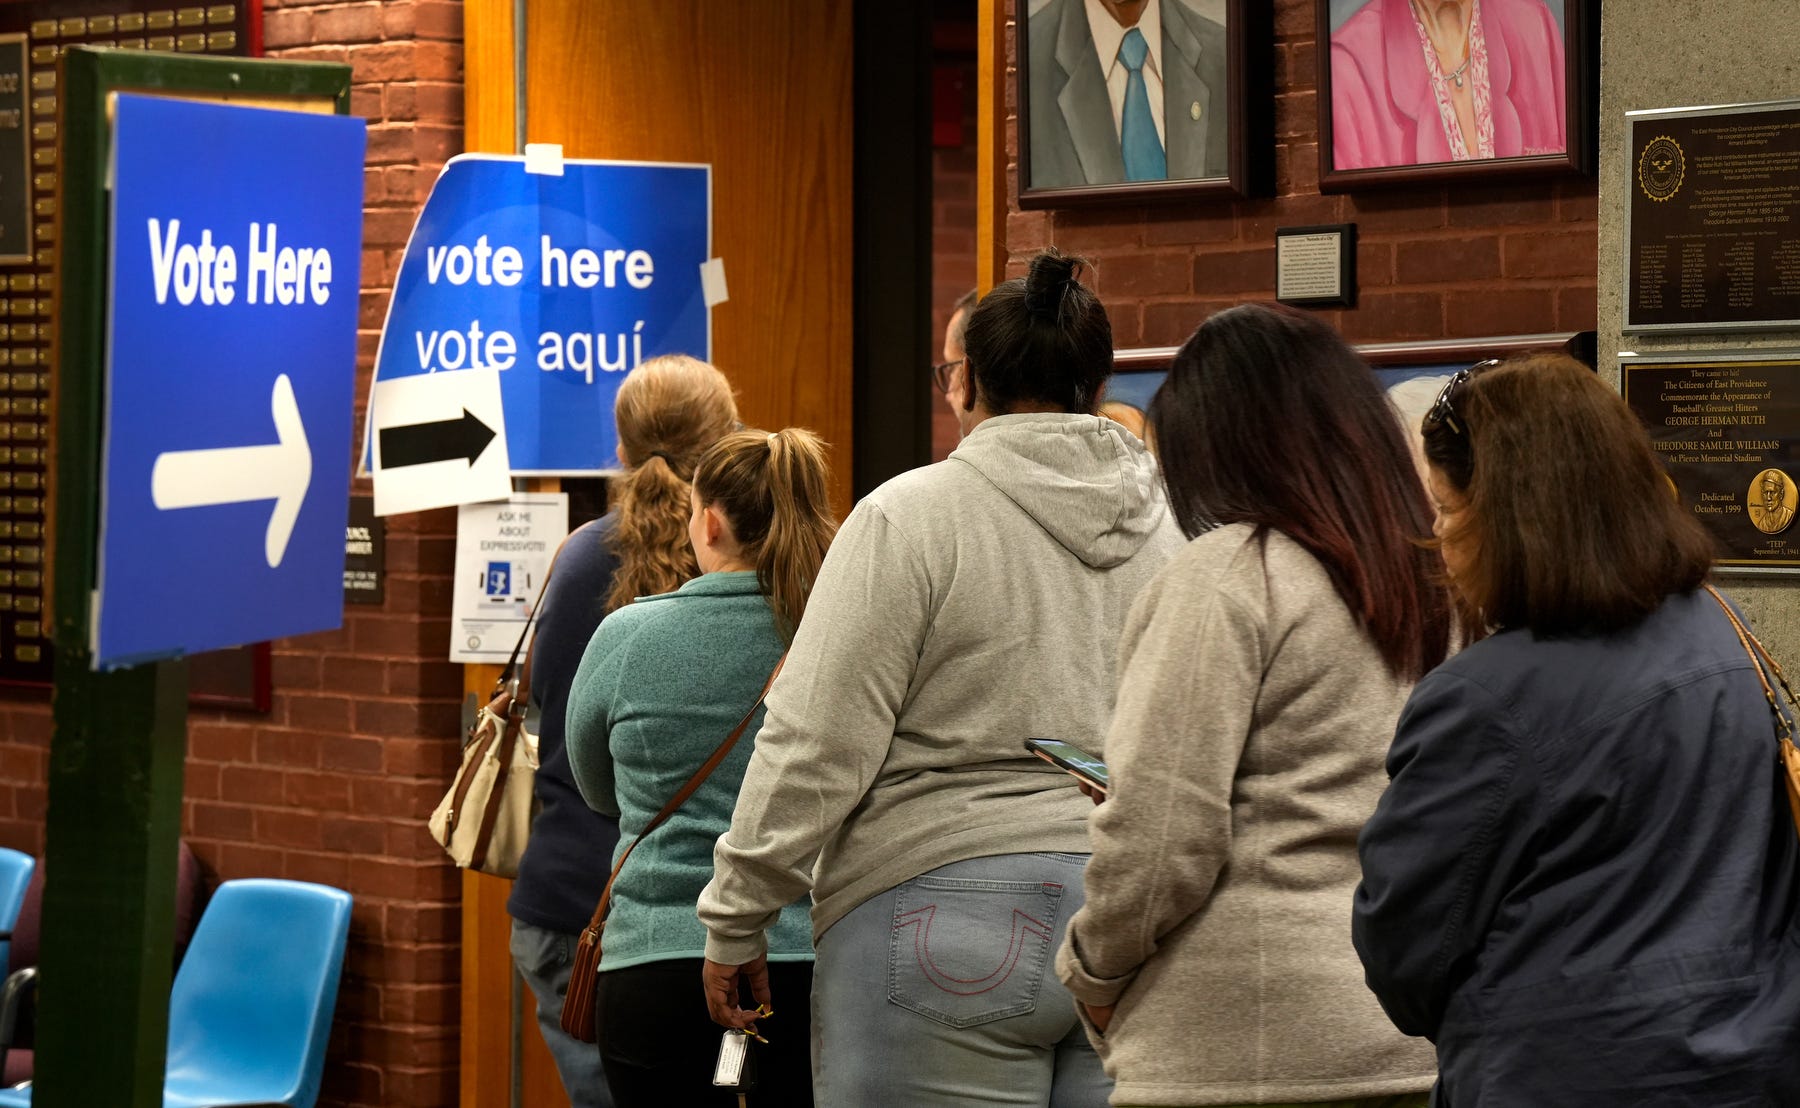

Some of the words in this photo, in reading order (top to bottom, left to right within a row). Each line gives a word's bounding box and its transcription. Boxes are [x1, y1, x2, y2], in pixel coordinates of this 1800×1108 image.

[147, 217, 238, 306] Vote
[246, 222, 332, 306] Here
[427, 234, 523, 286] vote
[540, 234, 655, 289] here
[415, 319, 517, 371] vote
[537, 319, 646, 385] aquí
[1691, 369, 1705, 378] They
[1664, 381, 1677, 389] The
[1679, 380, 1705, 389] Citizens
[1706, 380, 1714, 388] of
[1714, 380, 1728, 388] East
[1730, 379, 1768, 388] Providence
[1660, 393, 1709, 401] Commemorate
[1710, 392, 1720, 400] the
[1722, 392, 1762, 402] Appearance
[1764, 391, 1771, 399] of
[1672, 404, 1704, 413] Baseball's
[1706, 404, 1734, 412] Greatest
[1735, 404, 1758, 412] Hitters
[1665, 417, 1700, 425] GEORGE
[1701, 416, 1739, 425] HERMAN
[1740, 415, 1766, 425] RUTH
[1708, 429, 1722, 437] And
[1654, 441, 1699, 450] THEODORE
[1700, 441, 1734, 450] SAMUEL
[1736, 440, 1780, 450] WILLIAMS
[1678, 454, 1699, 462] Pierce
[1701, 454, 1733, 462] Memorial
[1734, 454, 1762, 462] Stadium
[1701, 493, 1734, 501] Dedicated
[1695, 505, 1723, 514] October,
[1725, 505, 1741, 513] 1999
[496, 512, 516, 522] ASK
[498, 526, 531, 536] ABOUT
